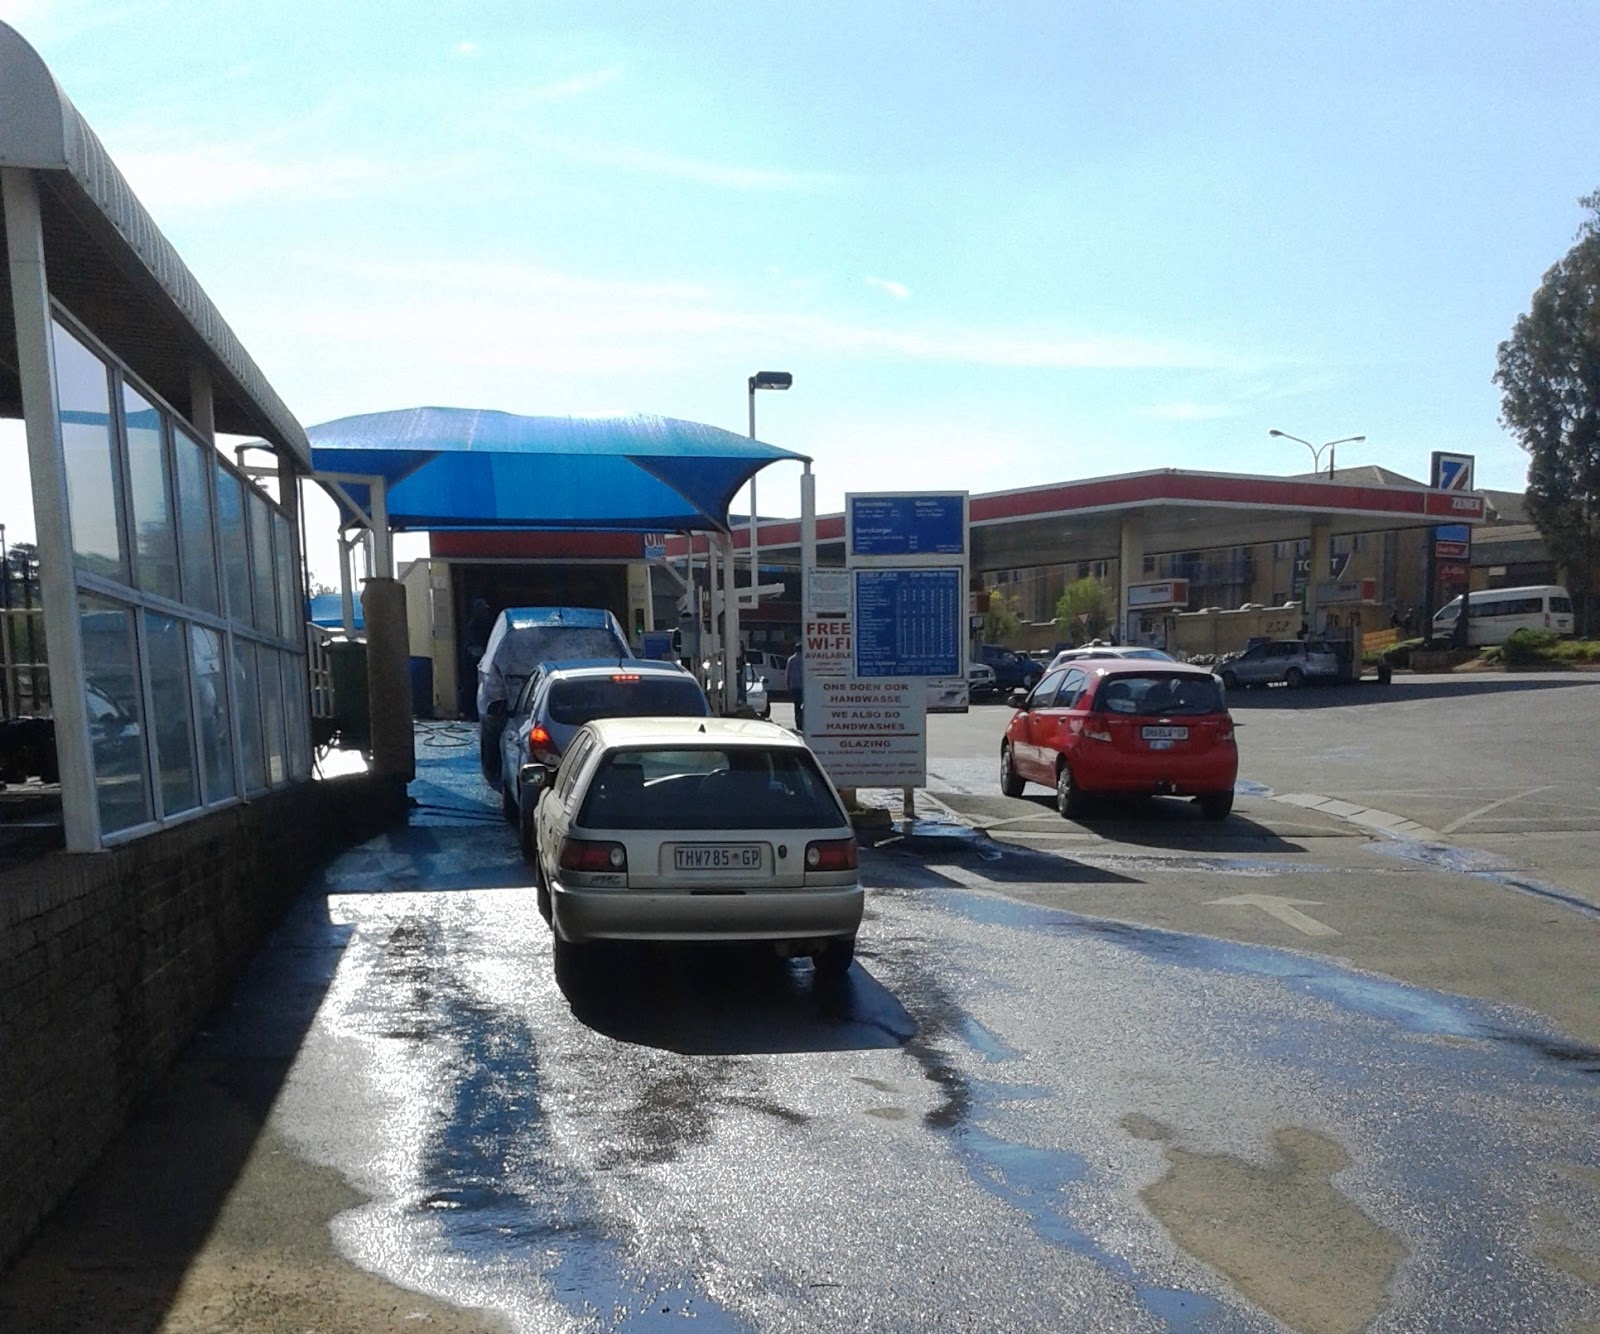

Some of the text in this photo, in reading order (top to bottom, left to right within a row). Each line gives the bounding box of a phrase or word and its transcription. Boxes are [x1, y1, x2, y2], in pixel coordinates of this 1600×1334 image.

[806, 622, 851, 635] FREE
[807, 637, 850, 650] WI-FI
[823, 683, 909, 691] ONS DOEN OOK
[830, 695, 901, 703] HANDWASSE
[831, 711, 900, 719] WE ALSO DO
[840, 740, 891, 748] GLAZING
[677, 850, 759, 866] THW785 GP
